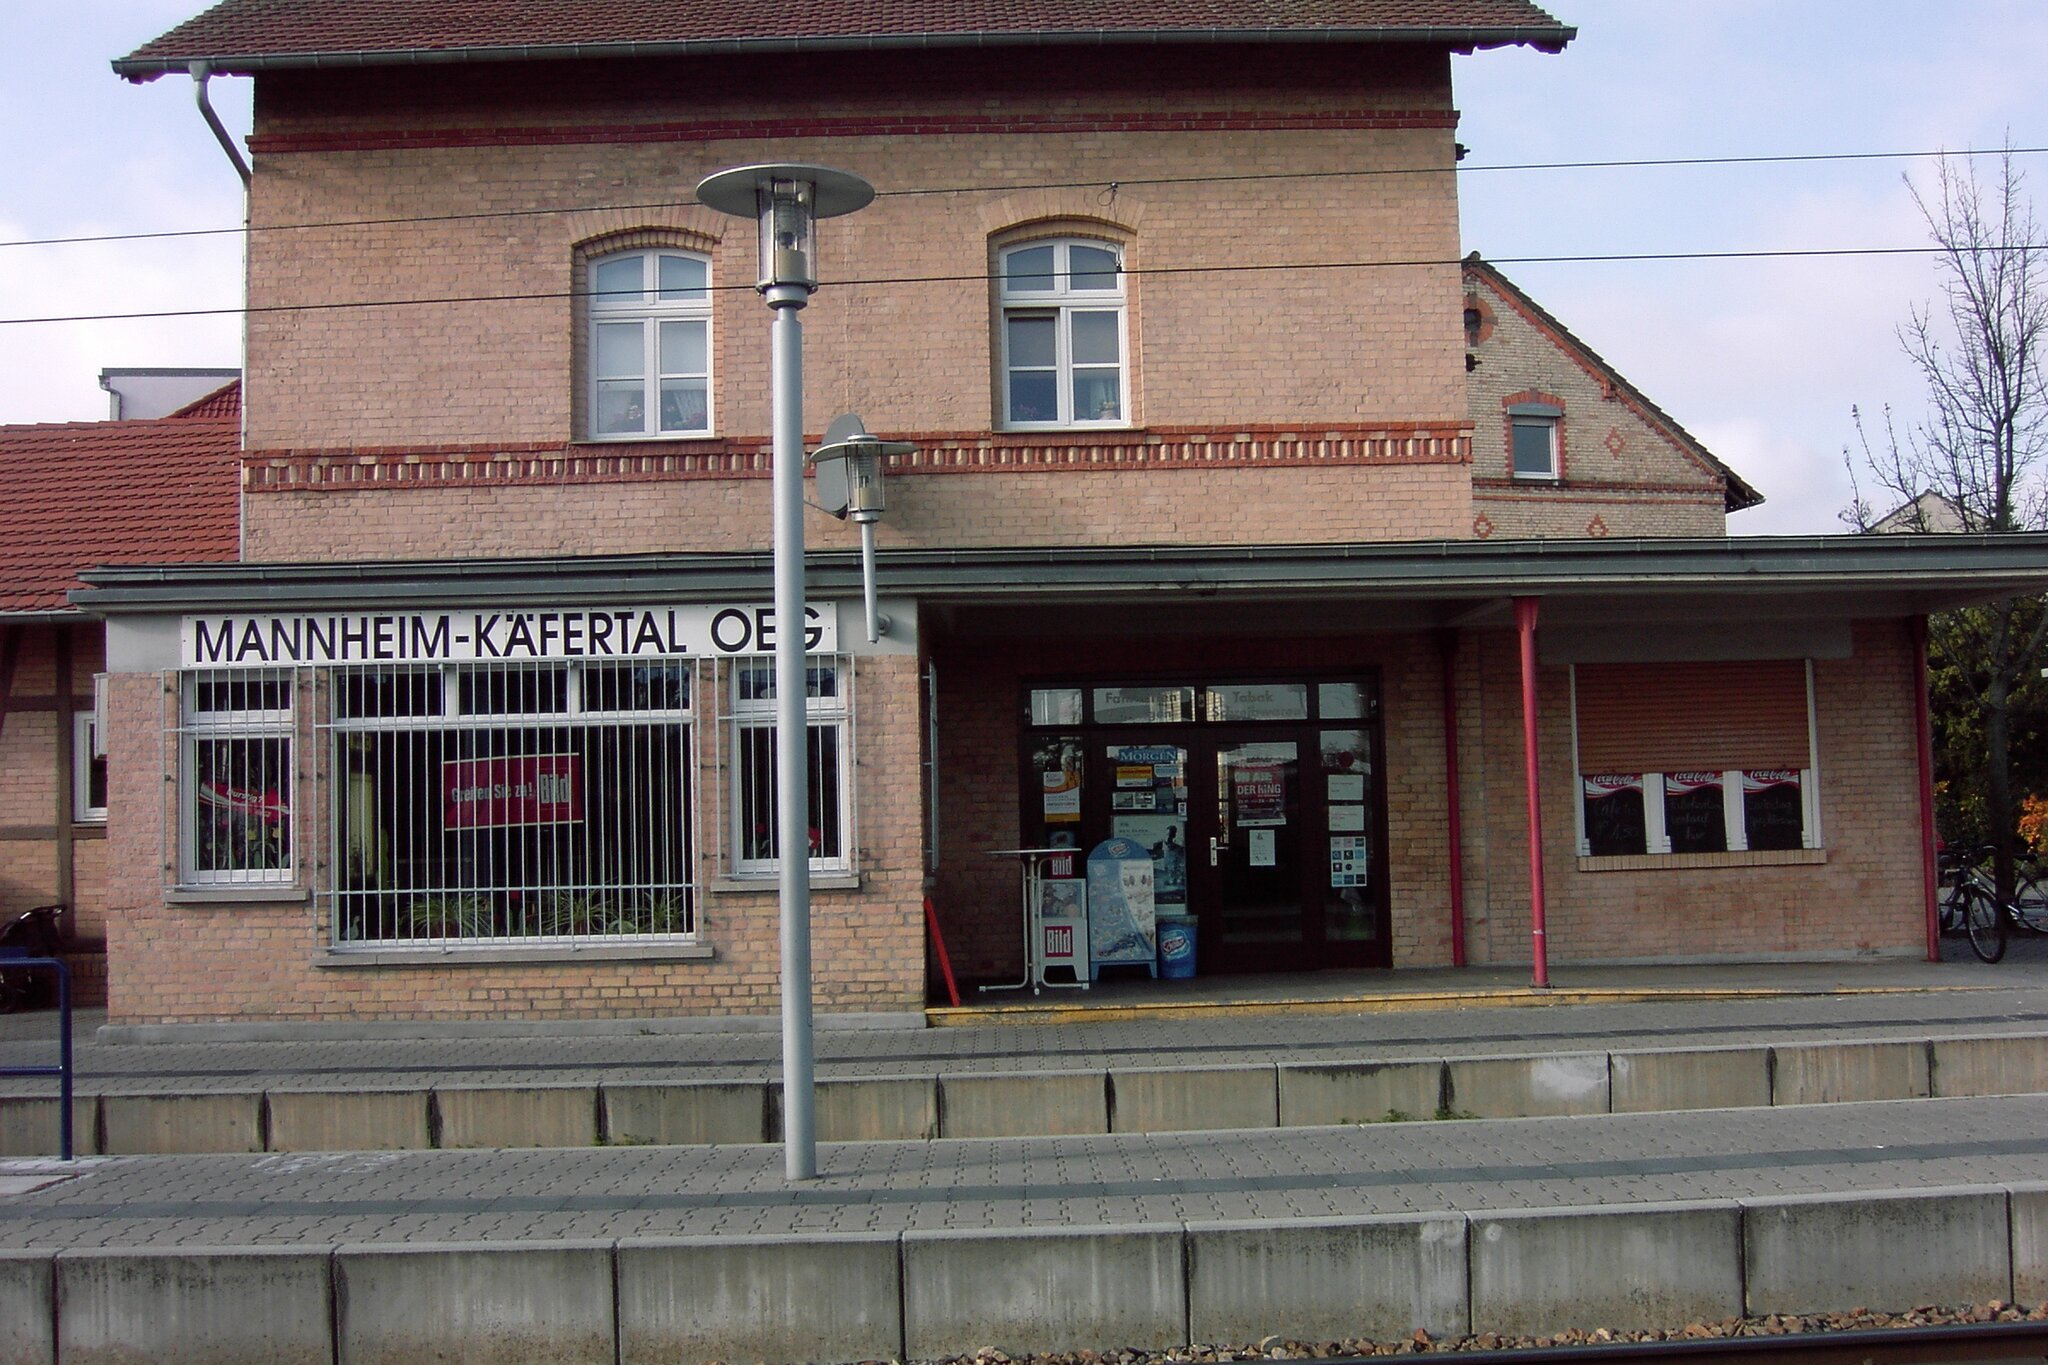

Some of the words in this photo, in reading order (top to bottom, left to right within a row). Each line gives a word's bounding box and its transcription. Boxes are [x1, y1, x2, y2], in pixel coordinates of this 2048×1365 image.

[195, 610, 687, 662] MANNHEIM-KÄFERTAL
[1232, 690, 1273, 703] Tabak
[1120, 751, 1176, 762] MORGEN
[494, 783, 511, 799] Sie
[539, 773, 570, 804] Bild
[1237, 785, 1256, 795] DER
[1052, 855, 1072, 876] Bild
[1046, 929, 1071, 954] Bild
